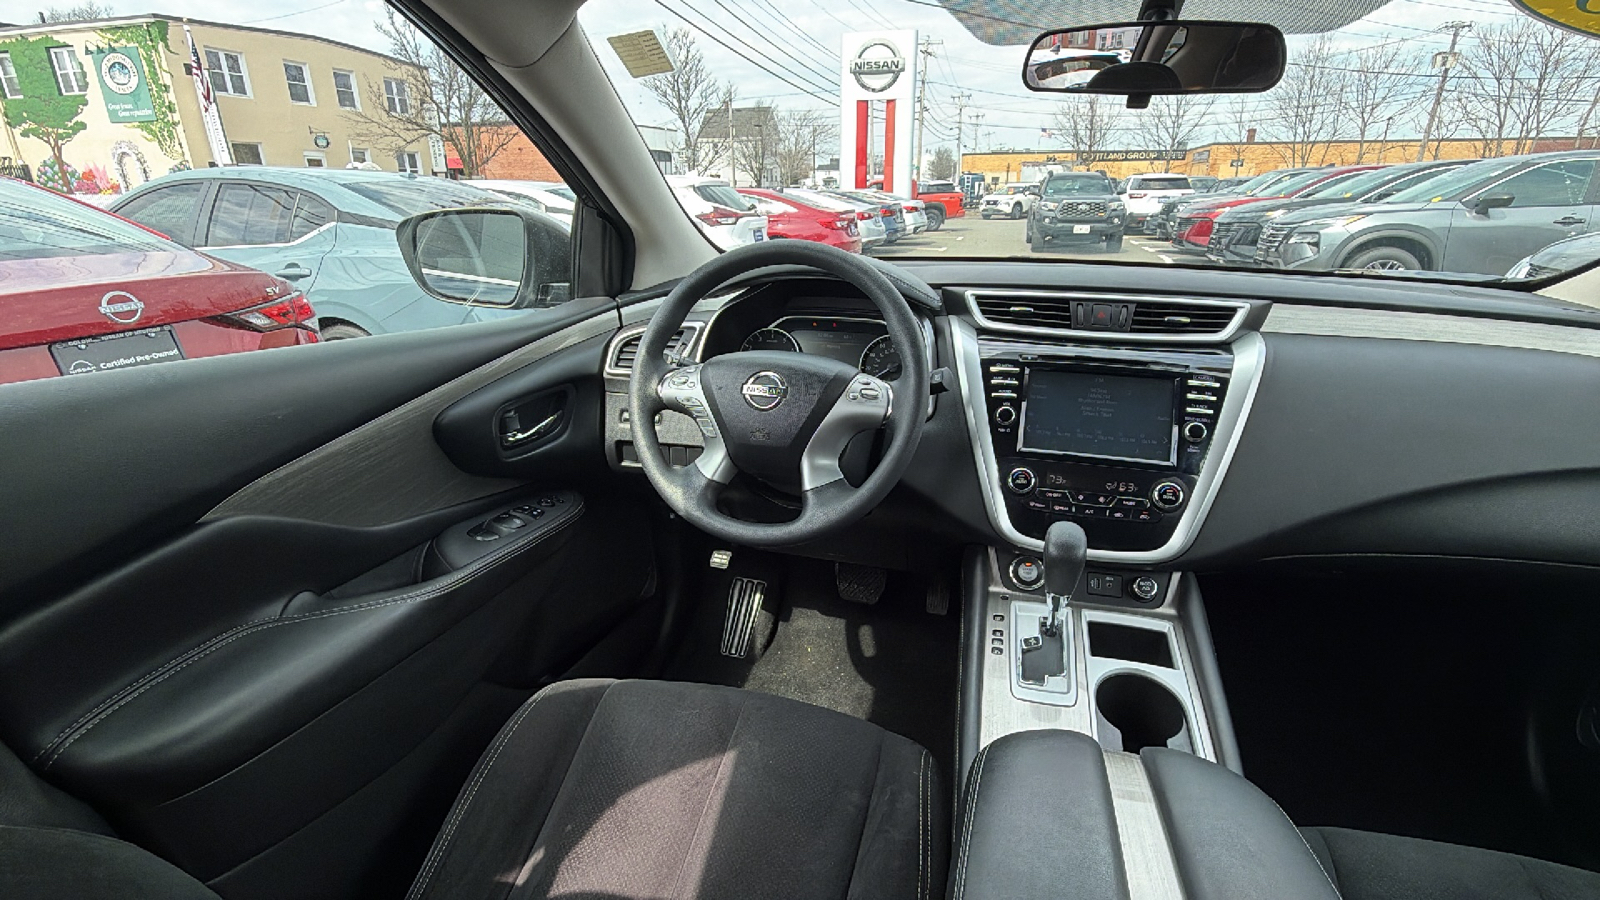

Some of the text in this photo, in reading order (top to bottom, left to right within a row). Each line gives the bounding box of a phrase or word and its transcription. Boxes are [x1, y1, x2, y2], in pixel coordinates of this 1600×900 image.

[854, 60, 900, 71] NISSAN
[1126, 151, 1158, 160] GROUP
[266, 287, 280, 297] SV
[98, 302, 144, 315] NISSAN
[99, 347, 179, 369] Certified Pre-Owned
[746, 386, 785, 396] NISSAN
